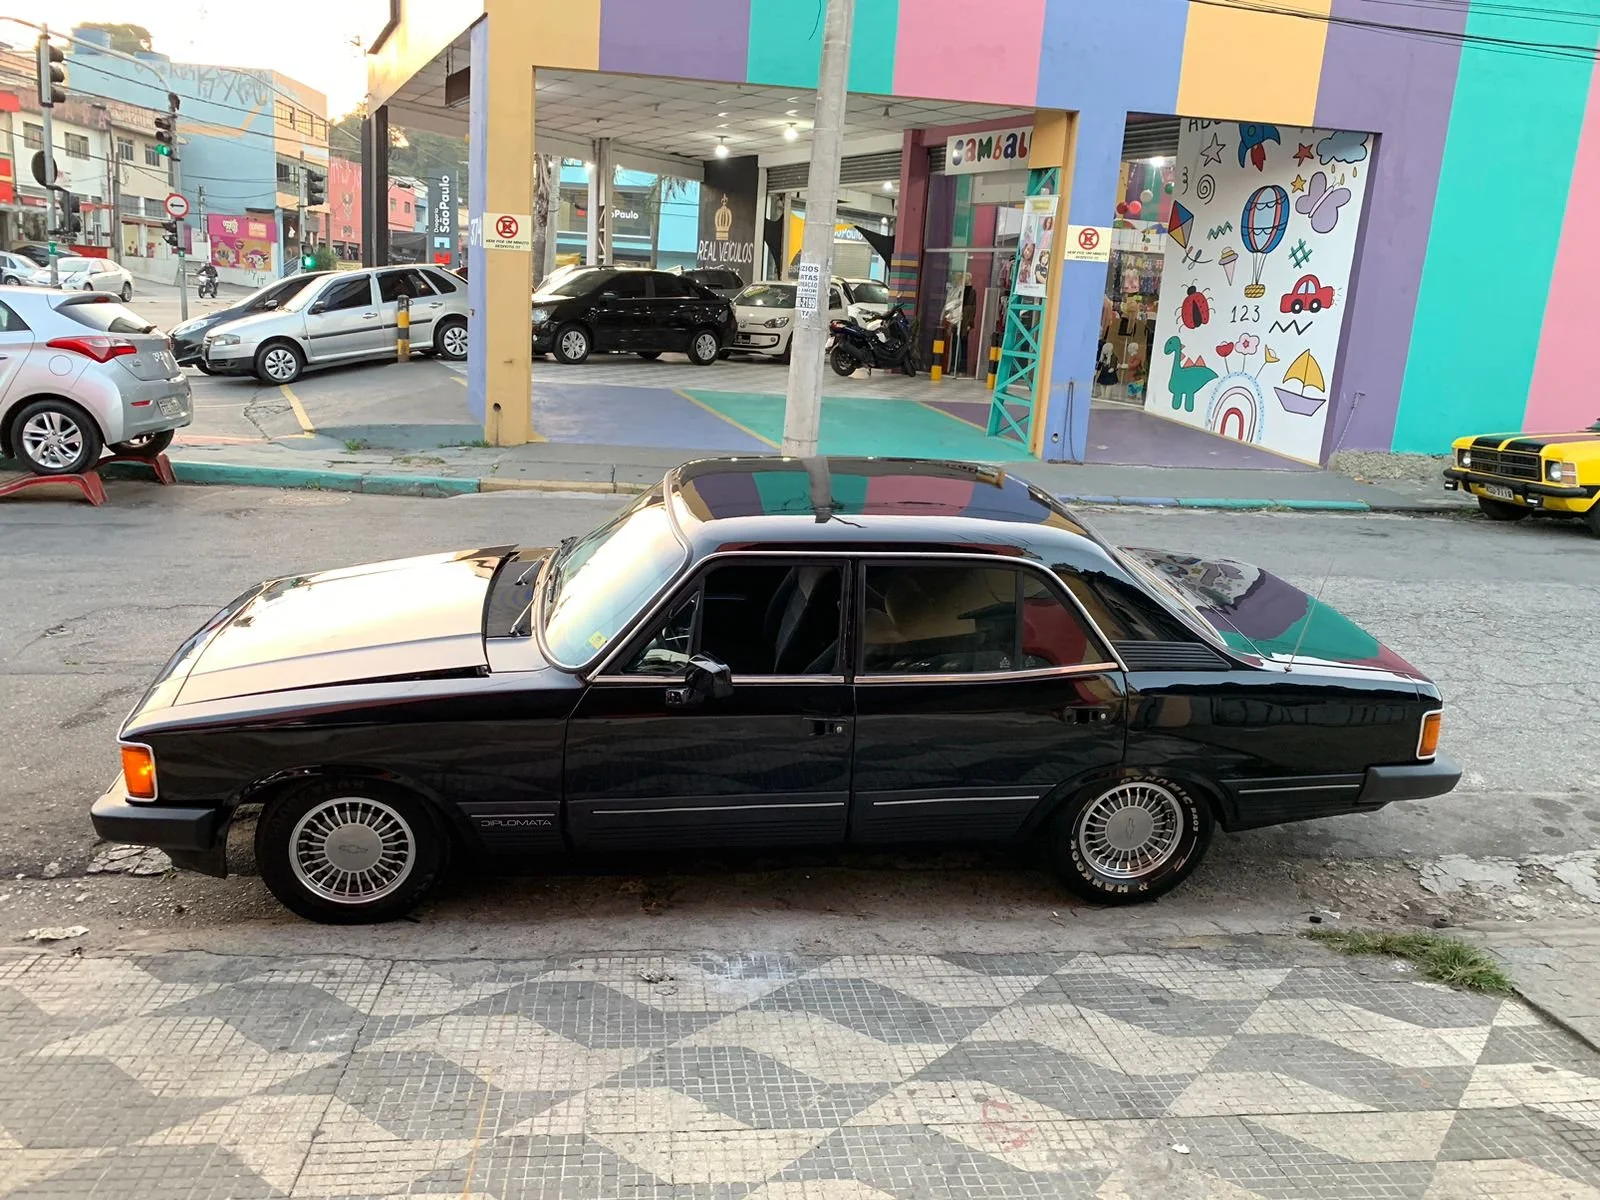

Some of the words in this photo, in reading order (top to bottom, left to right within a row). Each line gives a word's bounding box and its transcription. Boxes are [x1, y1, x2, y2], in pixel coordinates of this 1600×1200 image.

[697, 239, 717, 262] REAL
[1230, 305, 1260, 323] 123
[1120, 775, 1193, 805] DYNAMIC
[480, 819, 552, 827] DIPLOMATA
[1070, 839, 1129, 893] HANKOOK
